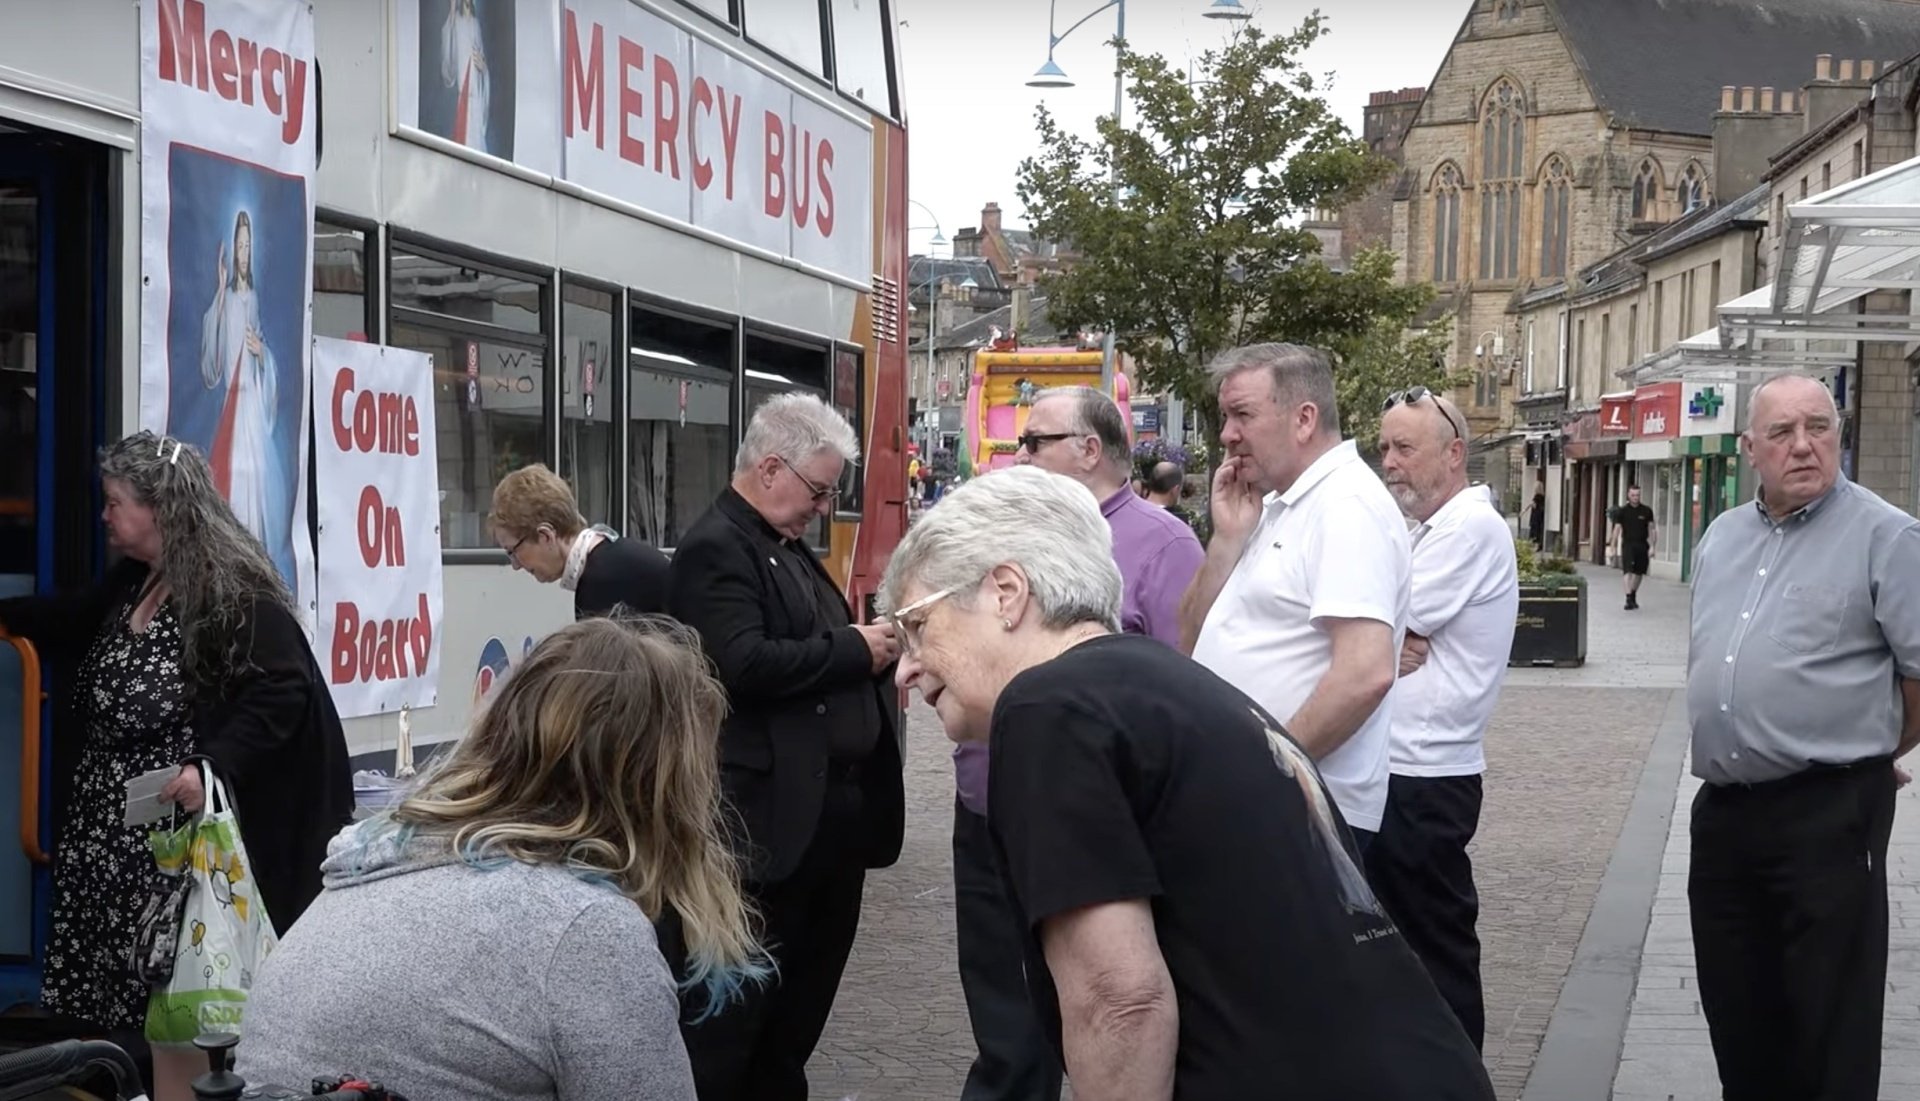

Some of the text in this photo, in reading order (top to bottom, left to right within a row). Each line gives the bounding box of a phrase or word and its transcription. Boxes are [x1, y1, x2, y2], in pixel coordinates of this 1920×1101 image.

[158, 0, 307, 145] Mercy
[565, 8, 834, 238] MERCY BUS
[332, 367, 419, 456] Come
[357, 485, 405, 568] On
[331, 593, 432, 685] Board
